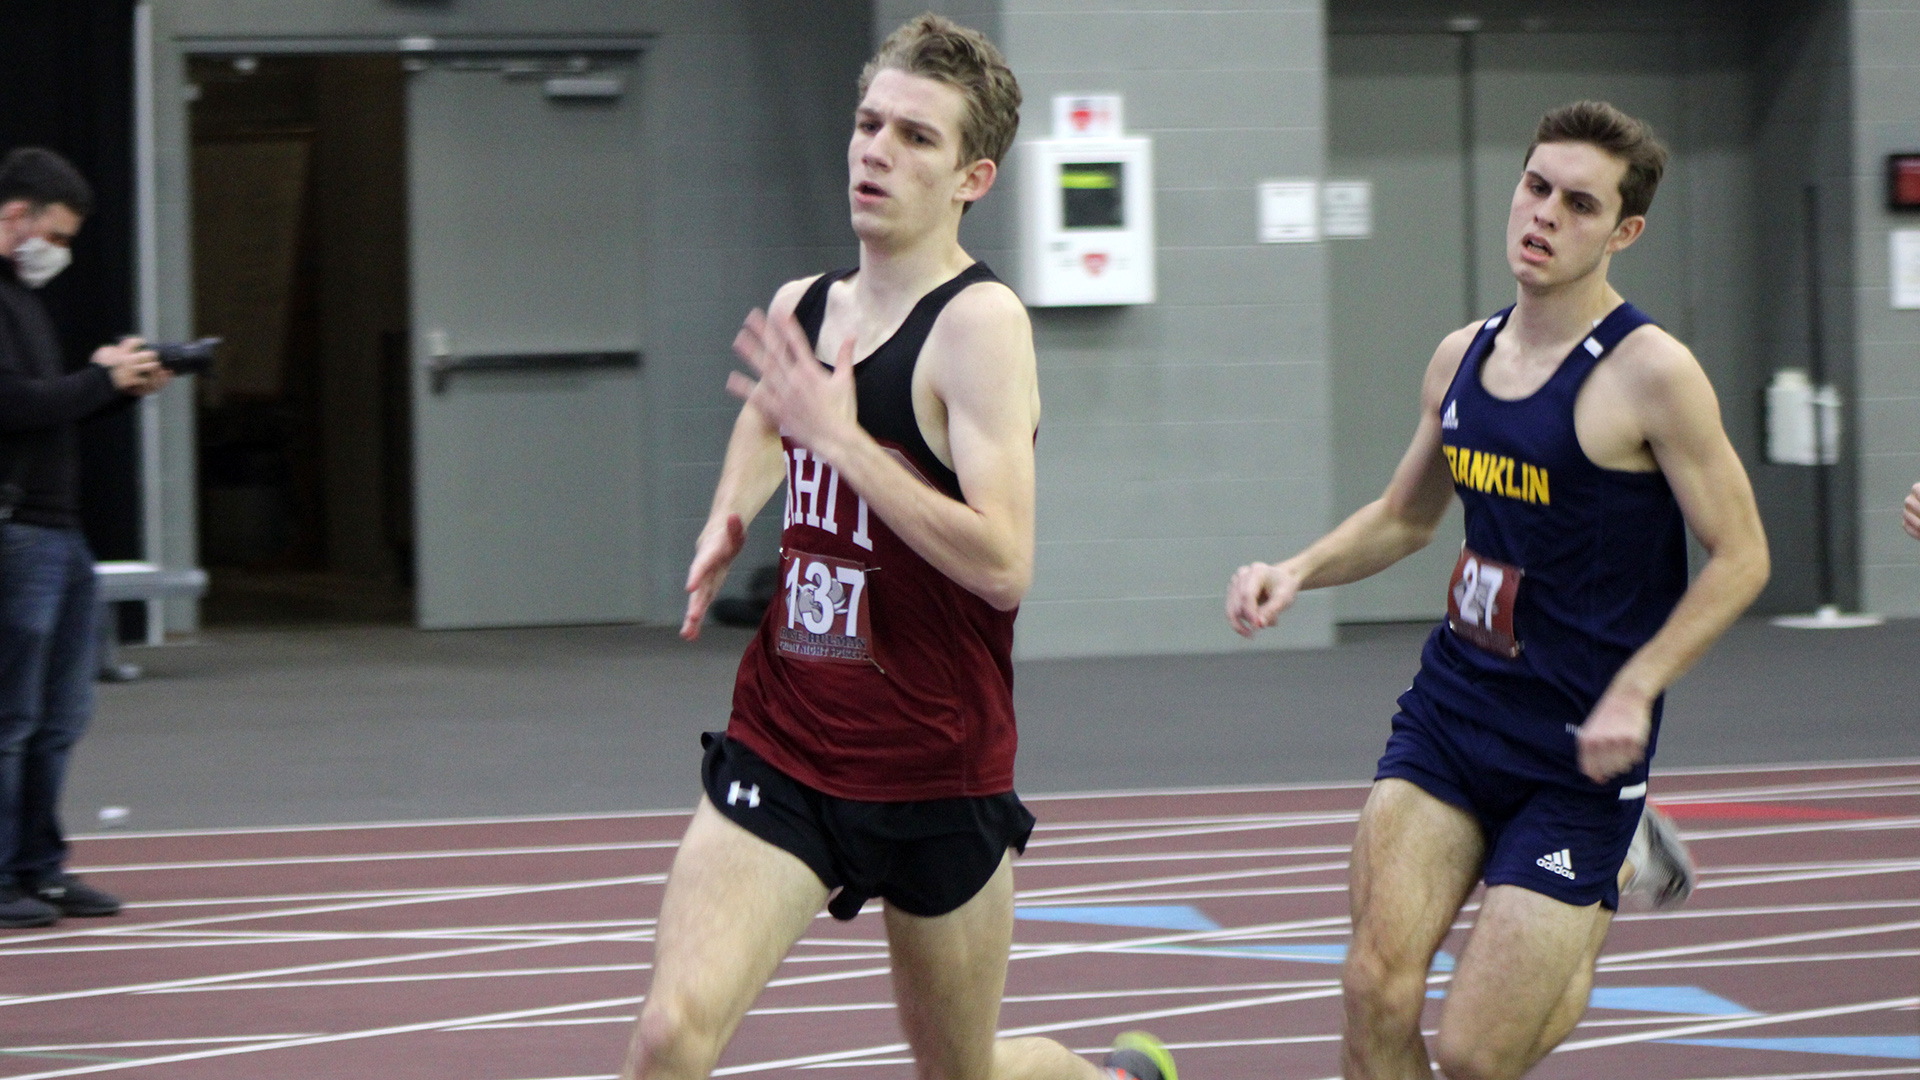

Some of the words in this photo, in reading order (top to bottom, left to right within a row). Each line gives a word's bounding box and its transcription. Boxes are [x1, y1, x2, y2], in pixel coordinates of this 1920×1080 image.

[785, 557, 865, 637] 137
[1460, 557, 1503, 632] 27
[1536, 858, 1575, 880] adidas
